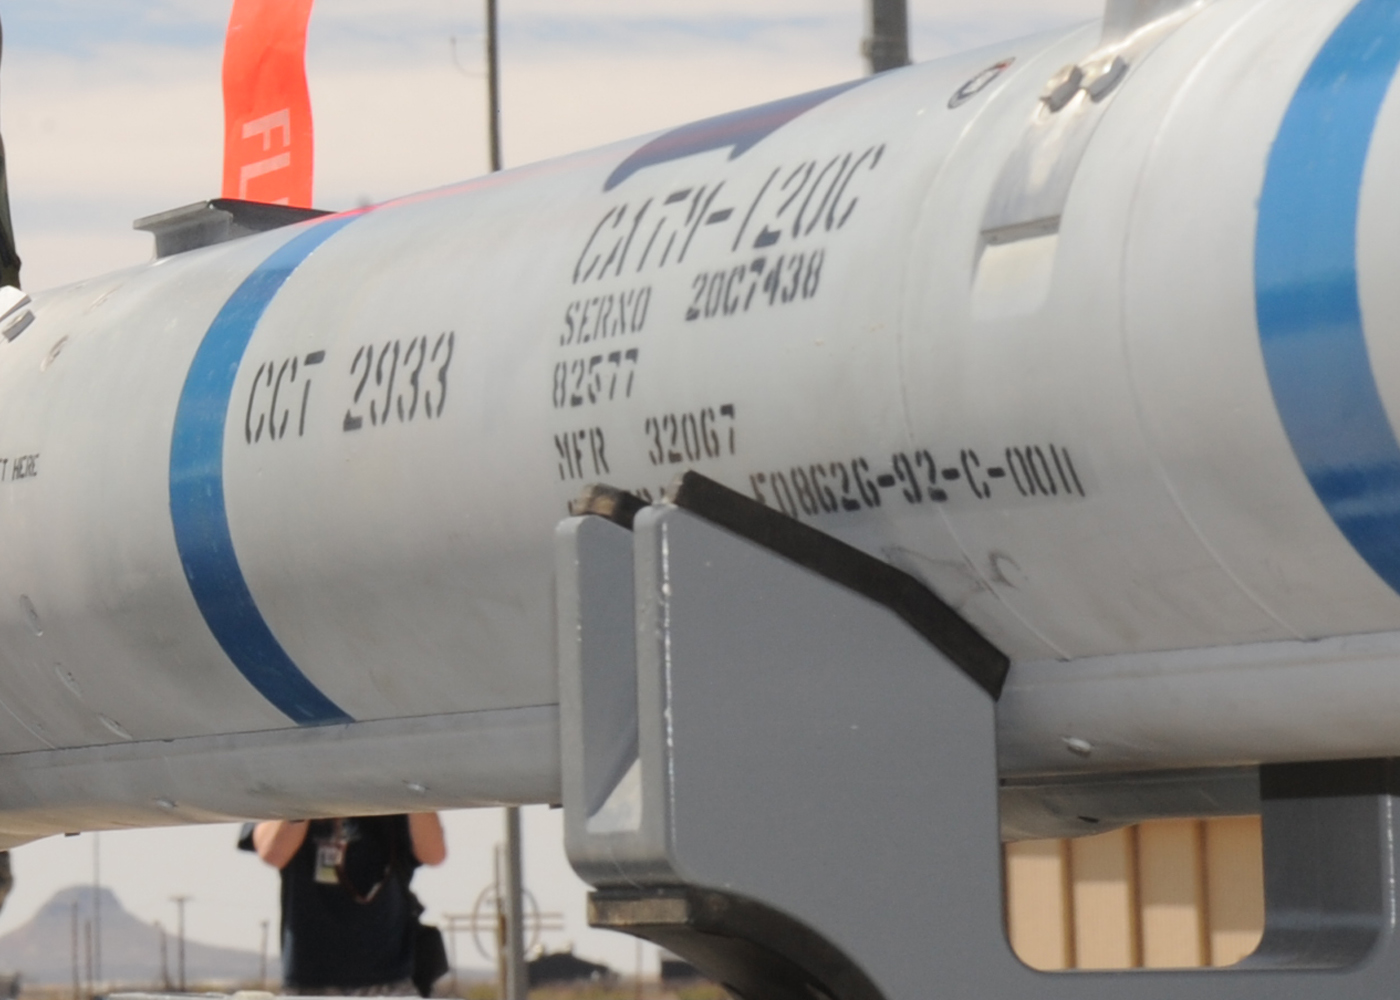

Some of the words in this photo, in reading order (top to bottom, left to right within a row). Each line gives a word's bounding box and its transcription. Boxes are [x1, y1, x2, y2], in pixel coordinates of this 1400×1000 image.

[238, 107, 291, 206] FL
[572, 143, 886, 285] CATM-120C
[244, 349, 326, 445] CCT
[342, 330, 455, 433] 2933
[552, 348, 639, 409] 82577
[11, 453, 40, 482] HERE
[554, 427, 611, 482] MFR
